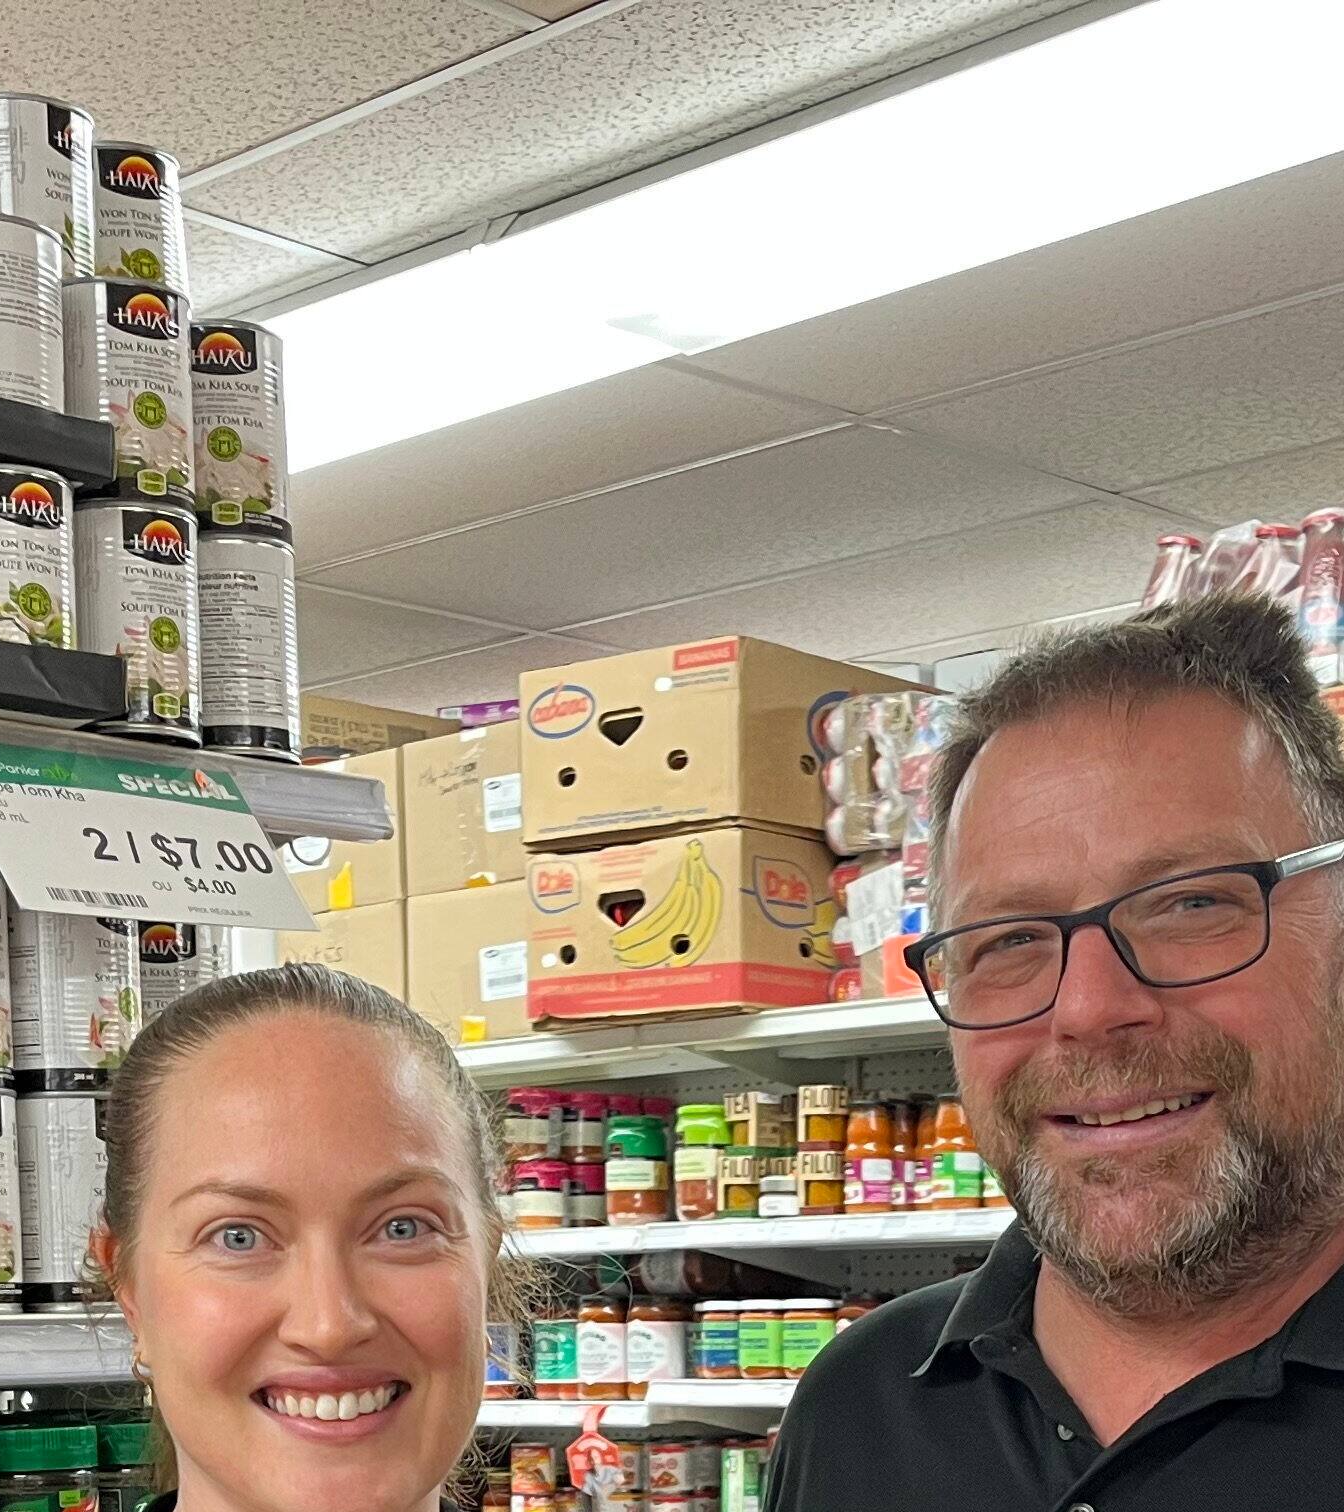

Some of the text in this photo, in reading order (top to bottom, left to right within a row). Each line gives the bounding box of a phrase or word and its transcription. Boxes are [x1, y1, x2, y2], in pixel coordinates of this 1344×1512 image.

[20, 783, 52, 799] Tom
[56, 786, 86, 803] Kha
[117, 772, 240, 801] SPÉCIAL
[82, 827, 119, 862] 2
[150, 832, 274, 876] $7.00
[152, 876, 237, 896] OU $4.00
